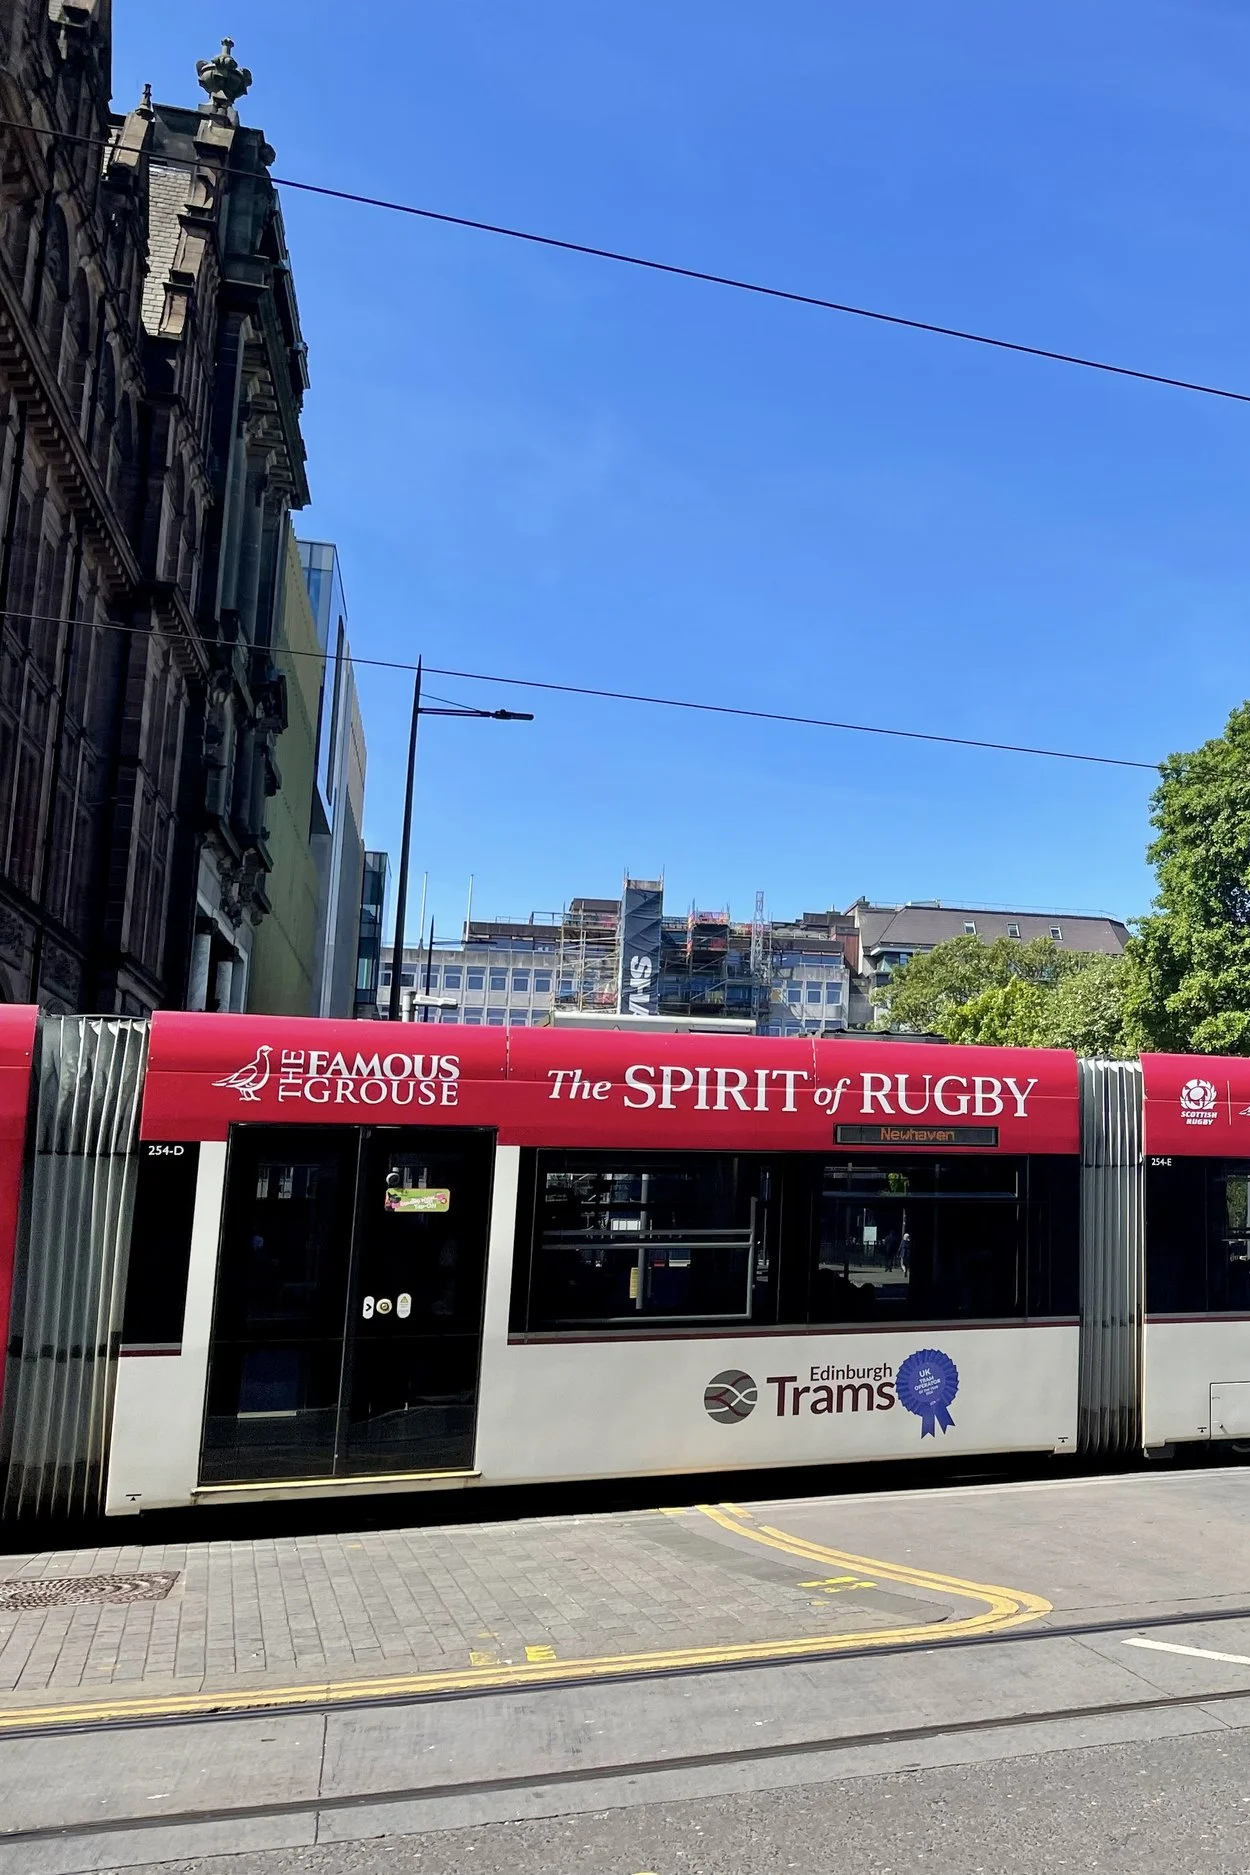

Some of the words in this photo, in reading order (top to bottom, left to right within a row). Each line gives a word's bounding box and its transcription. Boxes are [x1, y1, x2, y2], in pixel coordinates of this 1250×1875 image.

[279, 1050, 304, 1101] THE
[306, 1051, 460, 1081] FAMOUS
[304, 1078, 458, 1106] GROUSE
[547, 1070, 612, 1101] The
[623, 1065, 808, 1112] SPIRIT
[814, 1078, 851, 1116] of
[859, 1072, 1038, 1118] RUGBY
[880, 1127, 955, 1141] Newhaven
[148, 1145, 185, 1156] 254-D
[1151, 1158, 1172, 1167] 254-E
[810, 1363, 892, 1382] Edinburgh
[919, 1367, 931, 1378] UK
[766, 1375, 896, 1417] Trams
